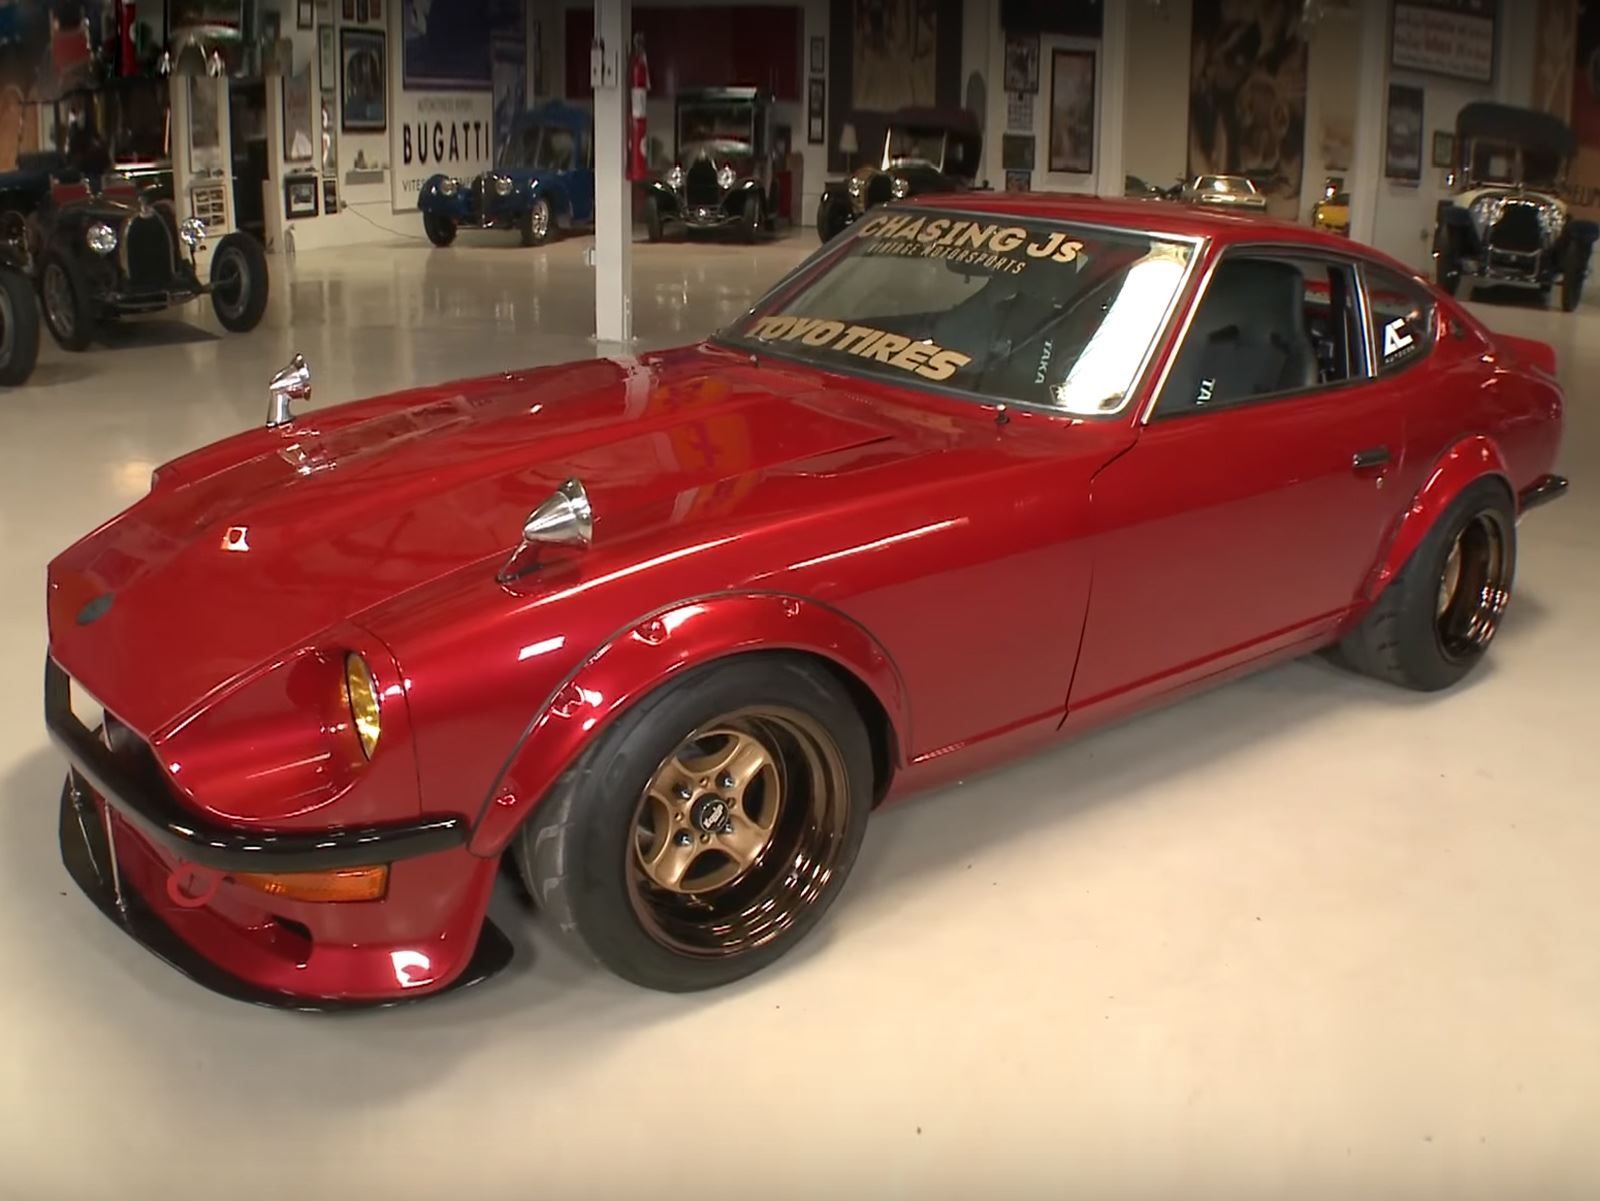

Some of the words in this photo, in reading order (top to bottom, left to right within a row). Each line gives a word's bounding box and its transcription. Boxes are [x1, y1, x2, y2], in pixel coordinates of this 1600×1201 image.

[403, 121, 489, 165] BUGATTI
[858, 215, 1027, 252] CHASING
[920, 246, 1027, 275] MOTORSPORTS
[744, 316, 845, 347] TOYO
[831, 325, 972, 381] TIRES
[1034, 339, 1053, 383] TAKA
